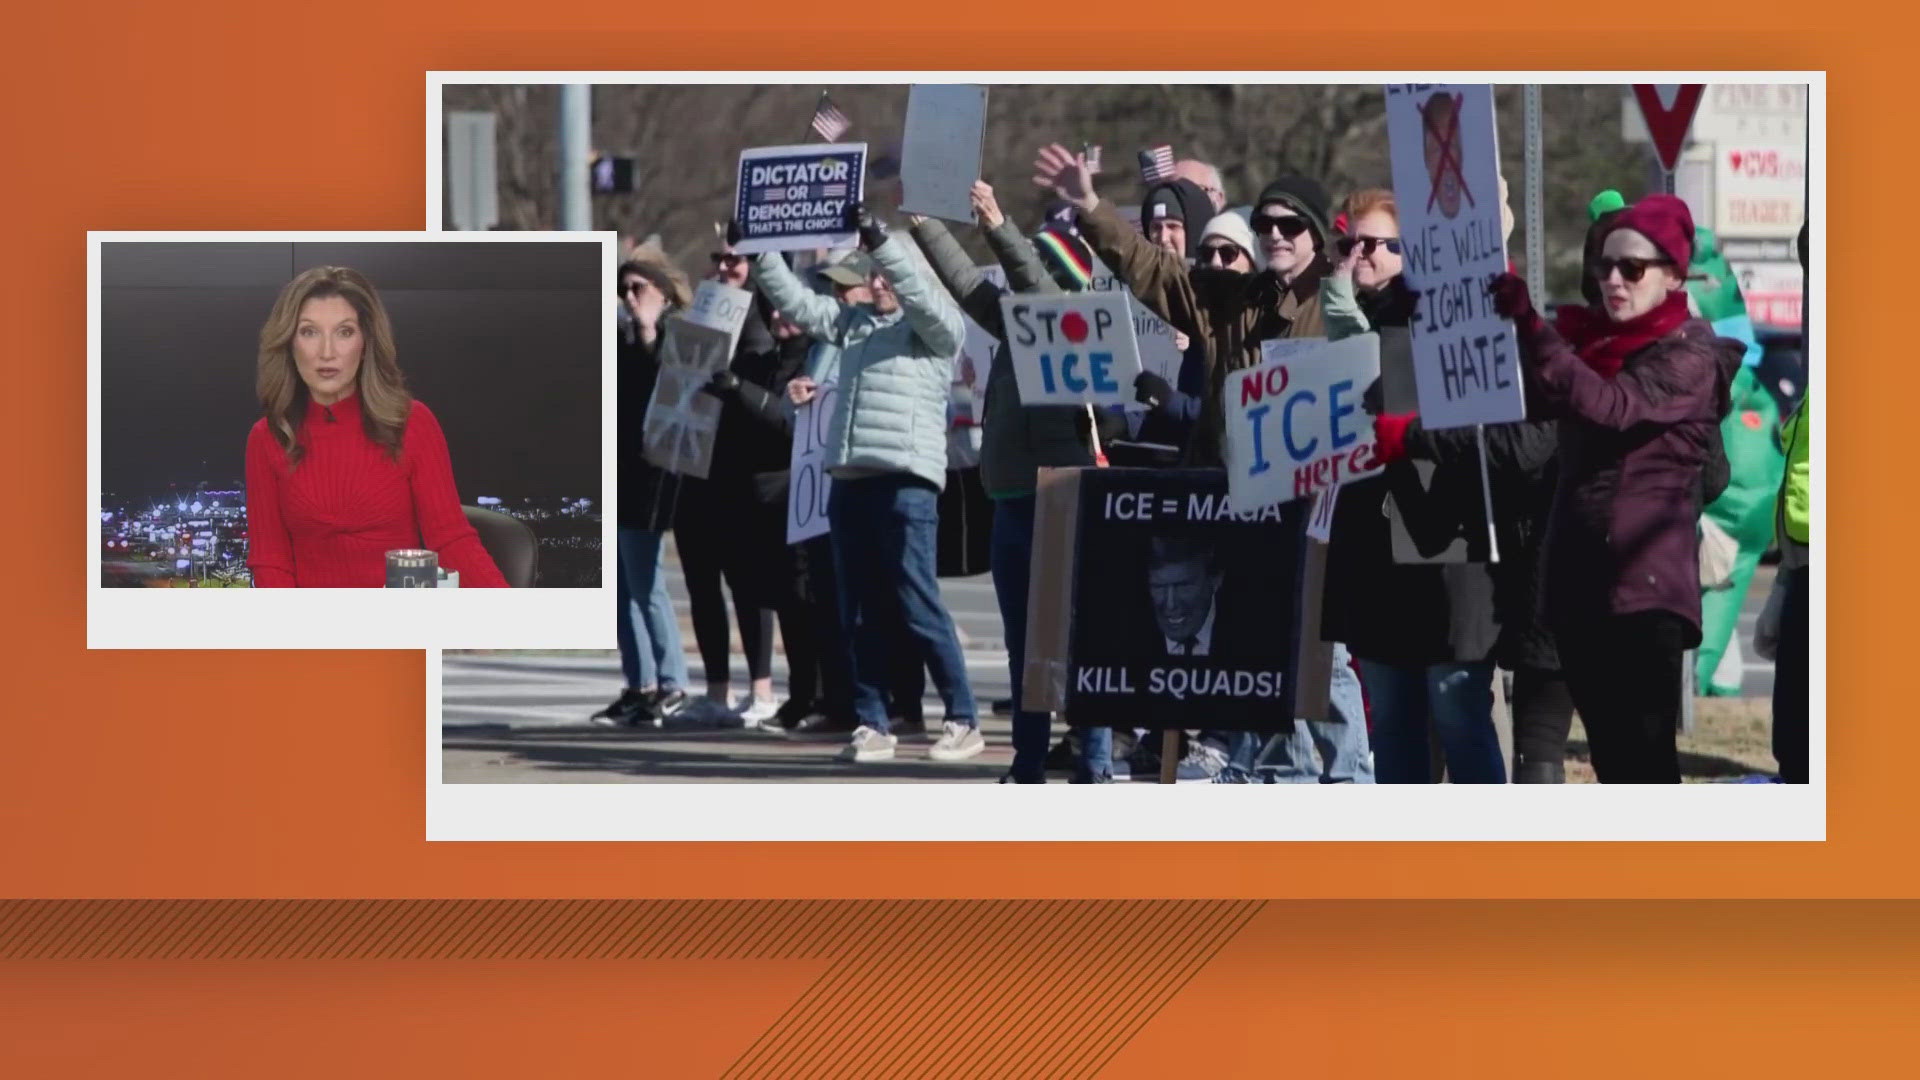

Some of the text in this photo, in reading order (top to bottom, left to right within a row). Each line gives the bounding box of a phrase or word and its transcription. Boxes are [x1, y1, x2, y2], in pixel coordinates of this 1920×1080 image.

[751, 161, 849, 187] DICTATOR
[786, 185, 810, 200] OR
[748, 200, 846, 221] DEMOCRACY
[748, 217, 844, 235] THAT'S THE CHOICE
[1402, 218, 1501, 276] WE WILL
[1012, 304, 1113, 346] STOP
[1039, 353, 1119, 395] ICE
[1438, 332, 1512, 402] HATE
[1241, 365, 1289, 408] NO
[1247, 379, 1357, 478] ICE
[1104, 492, 1154, 520] ICE
[1076, 667, 1282, 699] KILL SQUADS!
